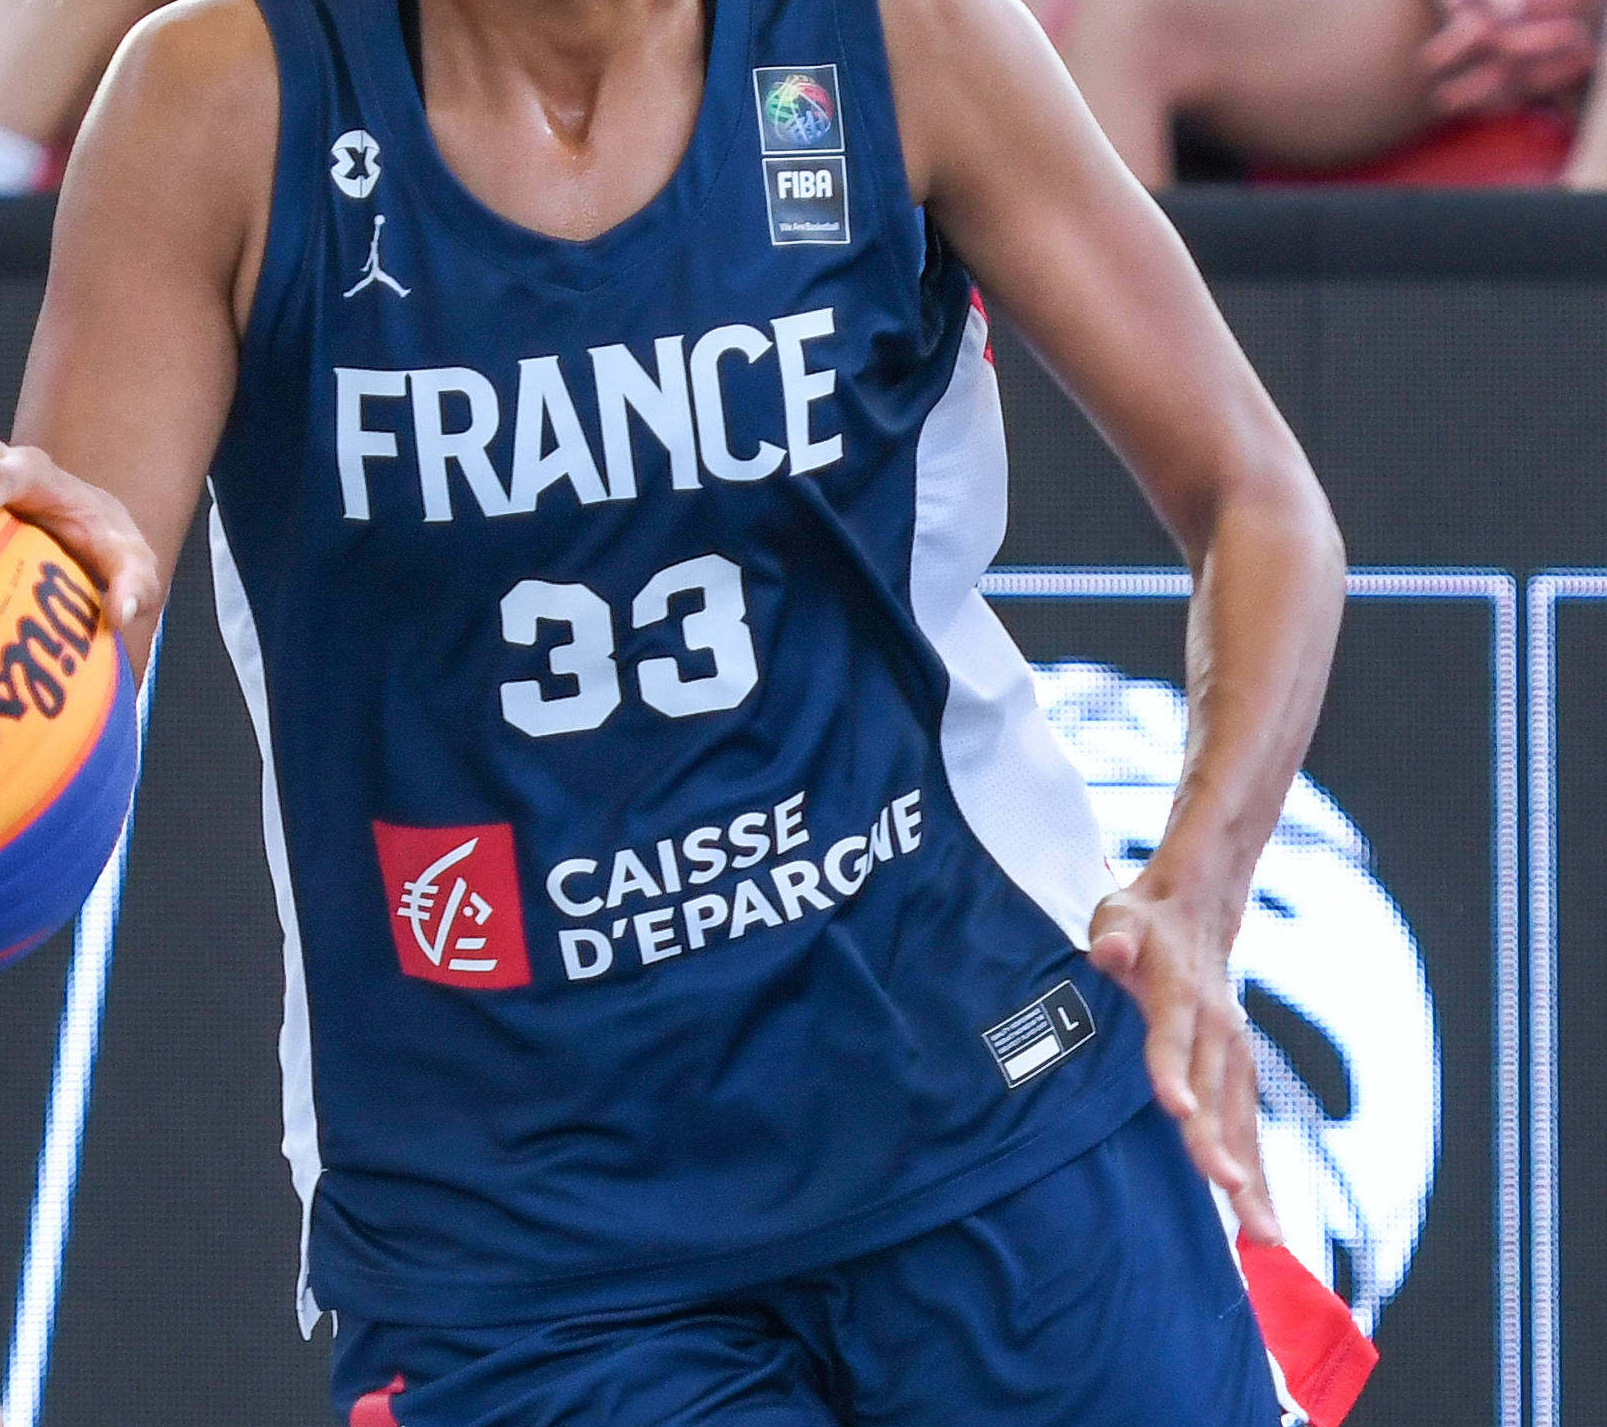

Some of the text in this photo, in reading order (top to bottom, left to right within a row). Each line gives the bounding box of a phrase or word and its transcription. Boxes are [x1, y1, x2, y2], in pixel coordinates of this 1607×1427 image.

[777, 169, 834, 200] FIBA
[334, 307, 844, 523] FRANCE
[499, 554, 760, 738] 33
[545, 790, 811, 918] CAISSE
[557, 788, 922, 982] D'EPARGNE
[1056, 1006, 1080, 1031] L
